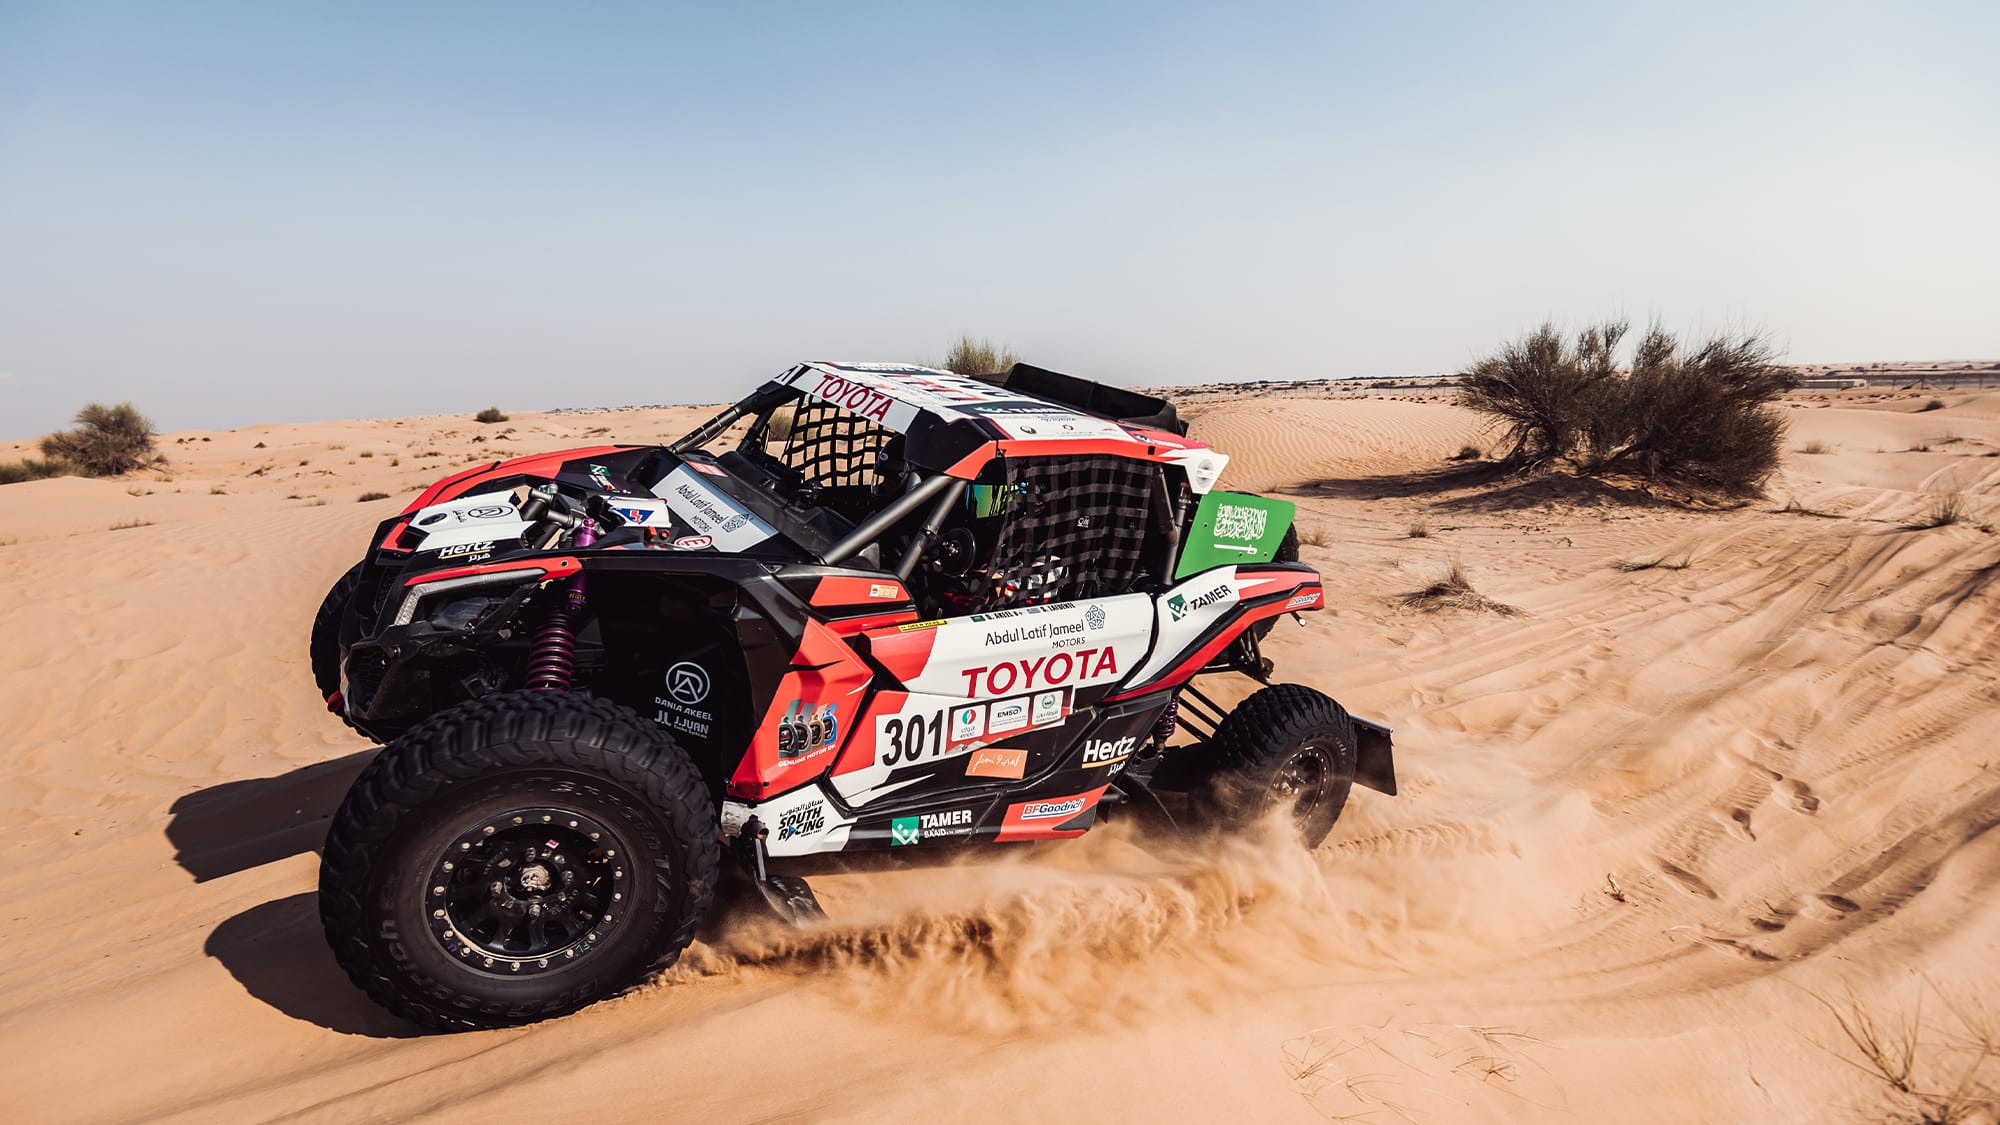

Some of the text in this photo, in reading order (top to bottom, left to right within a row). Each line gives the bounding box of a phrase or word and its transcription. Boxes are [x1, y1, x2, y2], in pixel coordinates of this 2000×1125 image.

[812, 374, 894, 422] TOYOTA
[675, 484, 729, 524] Abdul Latif Jameel
[1190, 584, 1233, 611] TAMER
[985, 619, 1085, 647] Abdul Latif Jameel
[1051, 637, 1086, 649] MOTORS
[961, 646, 1118, 699] TOYOTA
[655, 697, 713, 721] DANIA AKEEL
[997, 709, 1019, 718] EMSO
[674, 716, 709, 734] J.JUAN
[882, 709, 944, 766] 301
[1082, 736, 1137, 762] Hertz
[778, 806, 822, 830] SOUTH
[921, 809, 972, 829] TAMER
[1024, 799, 1084, 815] BFGoodrich
